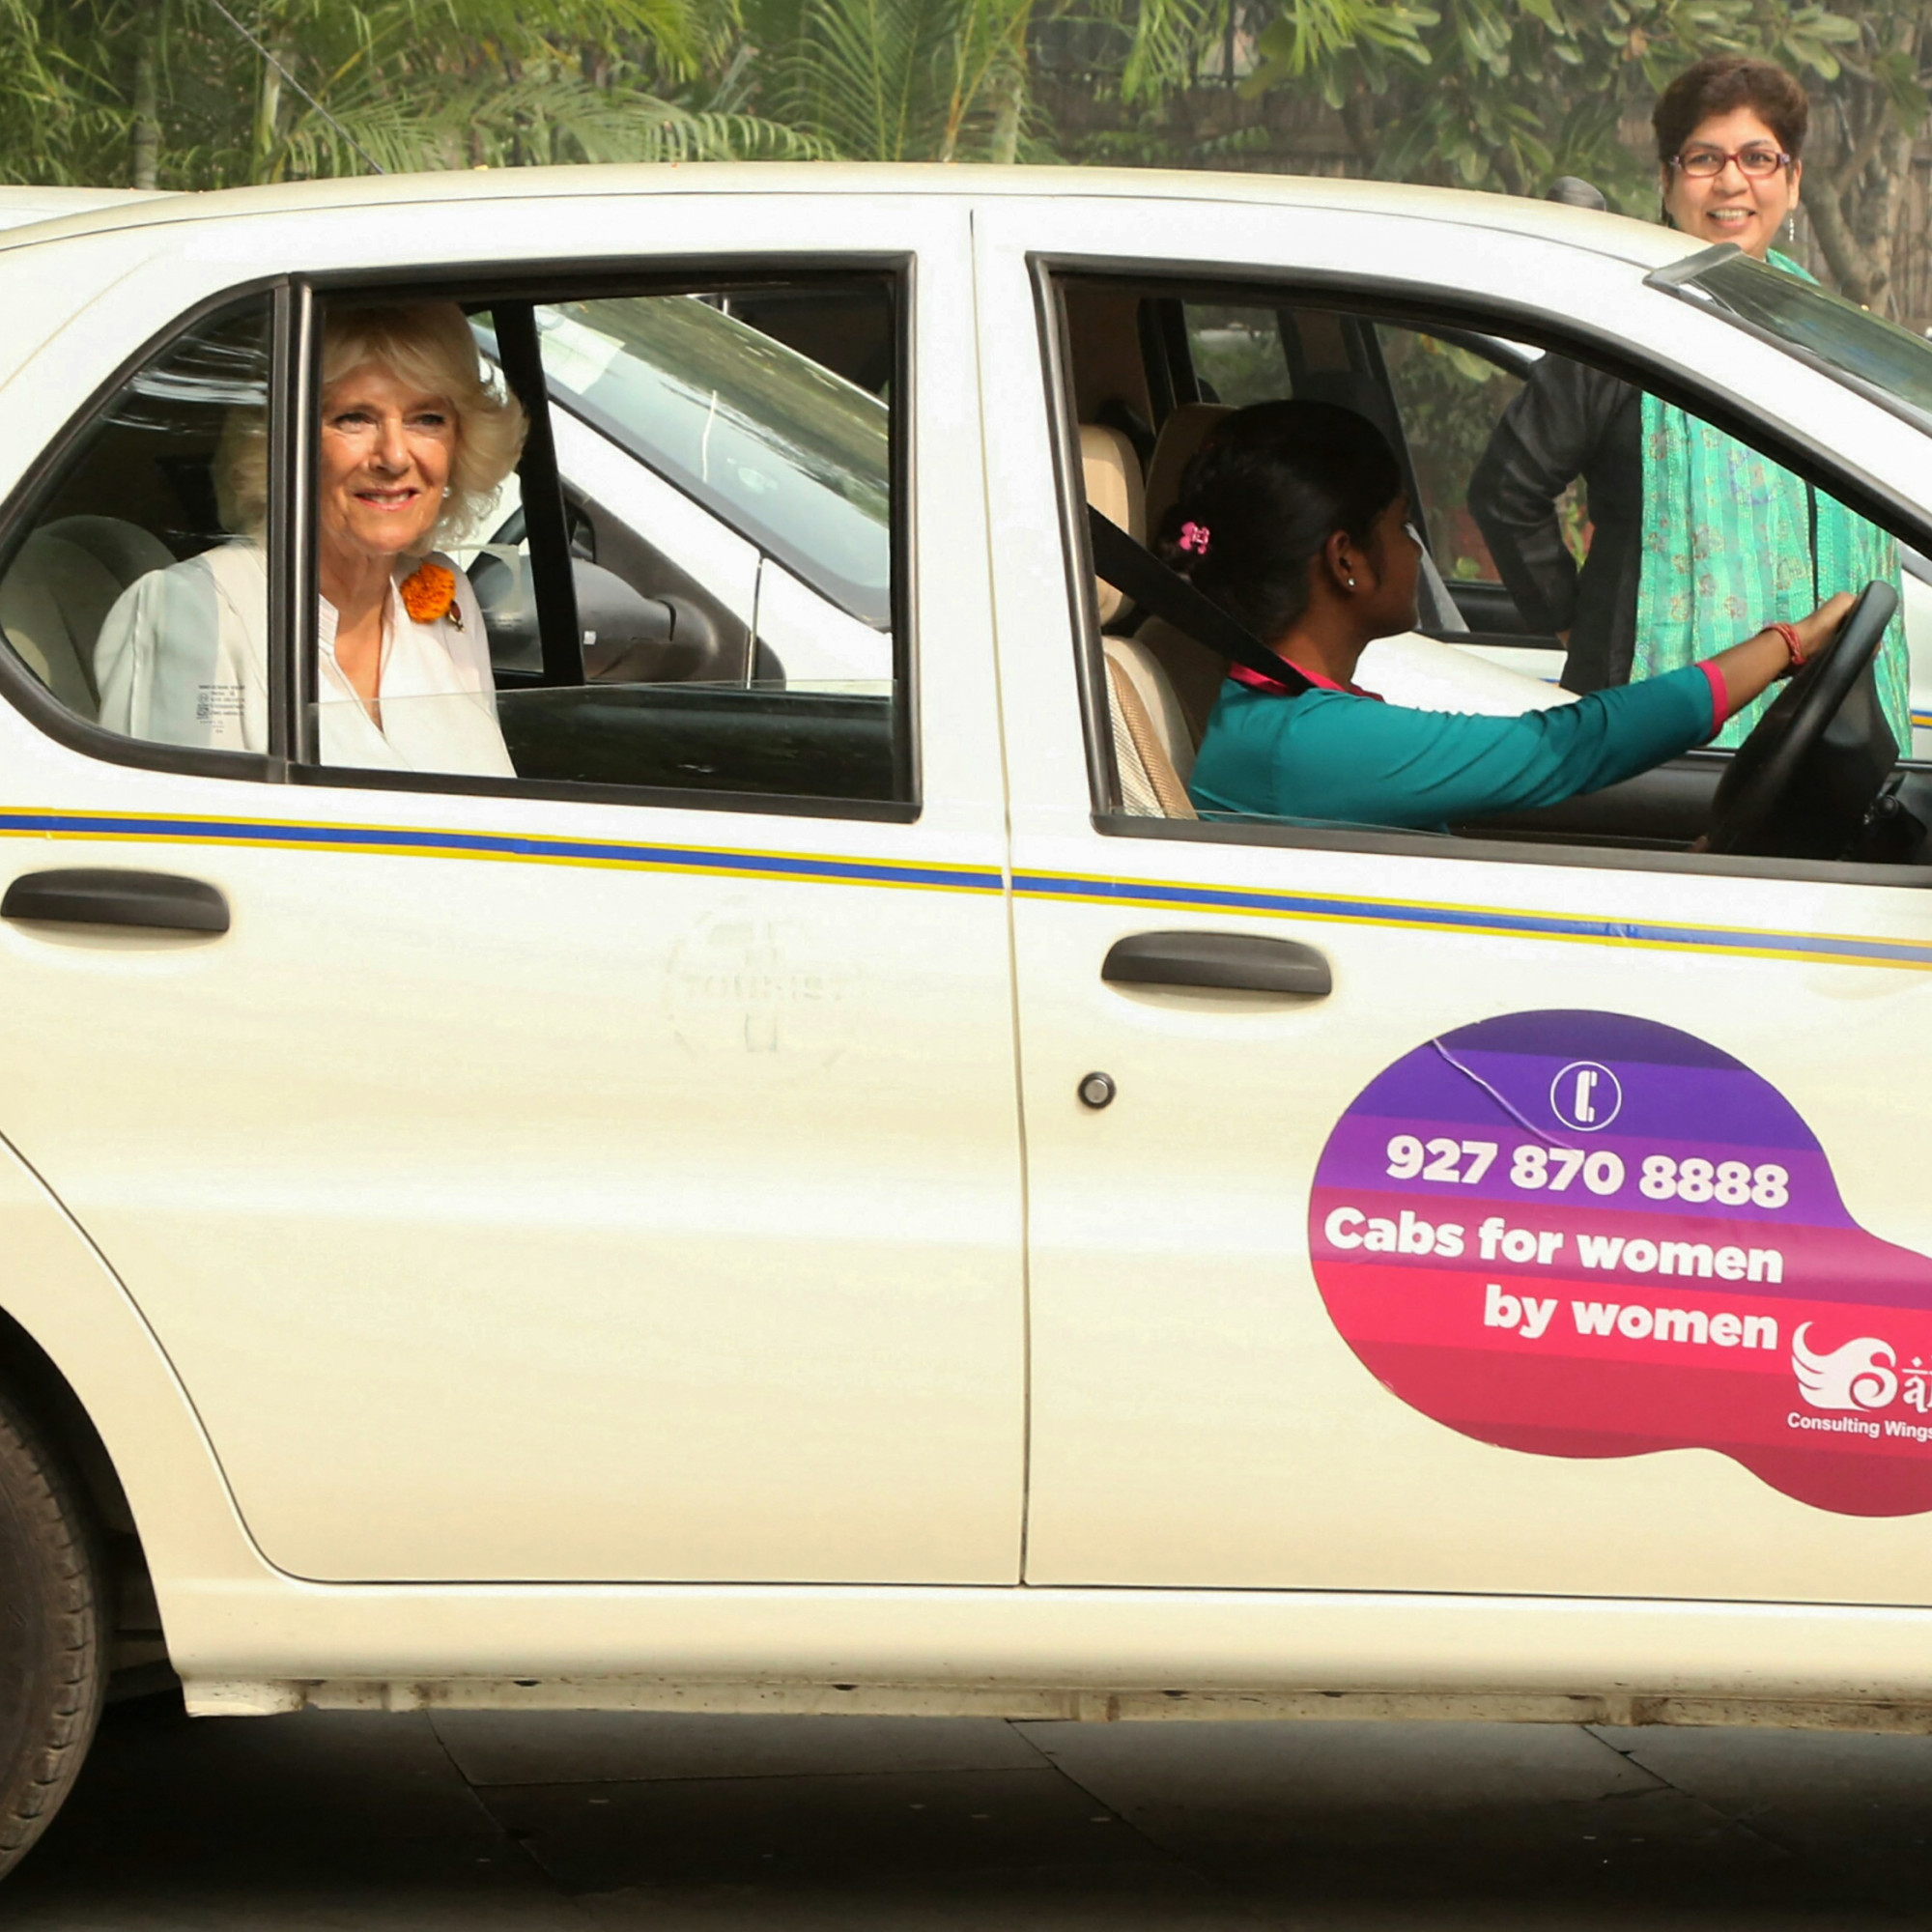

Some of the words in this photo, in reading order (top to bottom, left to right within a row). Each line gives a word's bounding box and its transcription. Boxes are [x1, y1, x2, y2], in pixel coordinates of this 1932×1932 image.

[1385, 1134, 1498, 1184] 927
[1509, 1144, 1625, 1195] 870
[1639, 1154, 1789, 1208] 8888
[1324, 1207, 1464, 1258] Cabs
[1478, 1217, 1564, 1264] for
[1576, 1234, 1783, 1284] women
[1483, 1284, 1558, 1339] by
[1571, 1301, 1778, 1350] women
[1787, 1411, 1880, 1438] Consulting
